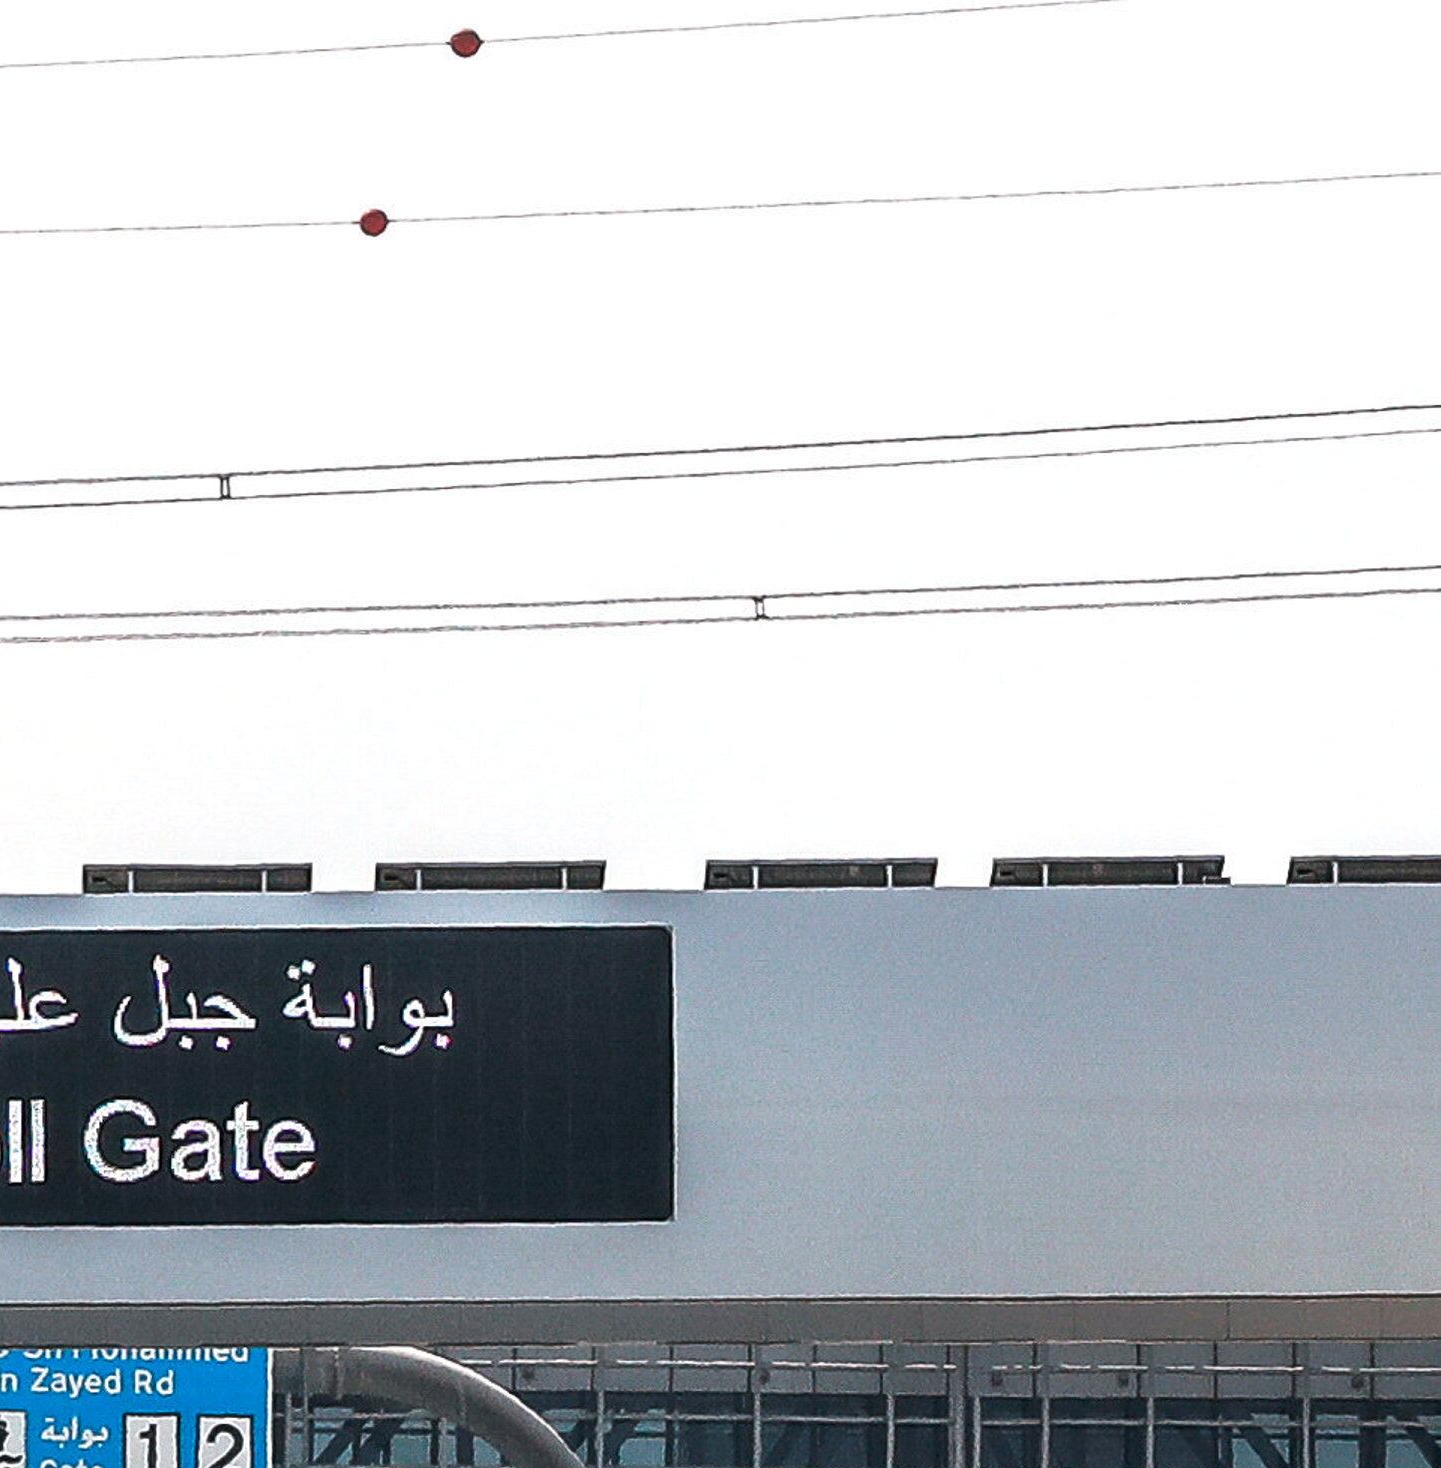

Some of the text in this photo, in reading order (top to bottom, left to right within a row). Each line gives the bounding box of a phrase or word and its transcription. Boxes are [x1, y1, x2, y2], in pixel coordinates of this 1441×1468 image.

[114, 955, 256, 1049] جبل
[283, 958, 454, 1056] بوابة
[84, 1099, 316, 1183] Gate
[30, 1366, 121, 1398] Zayed
[134, 1368, 174, 1395] Rd
[41, 1416, 109, 1449] بوابة
